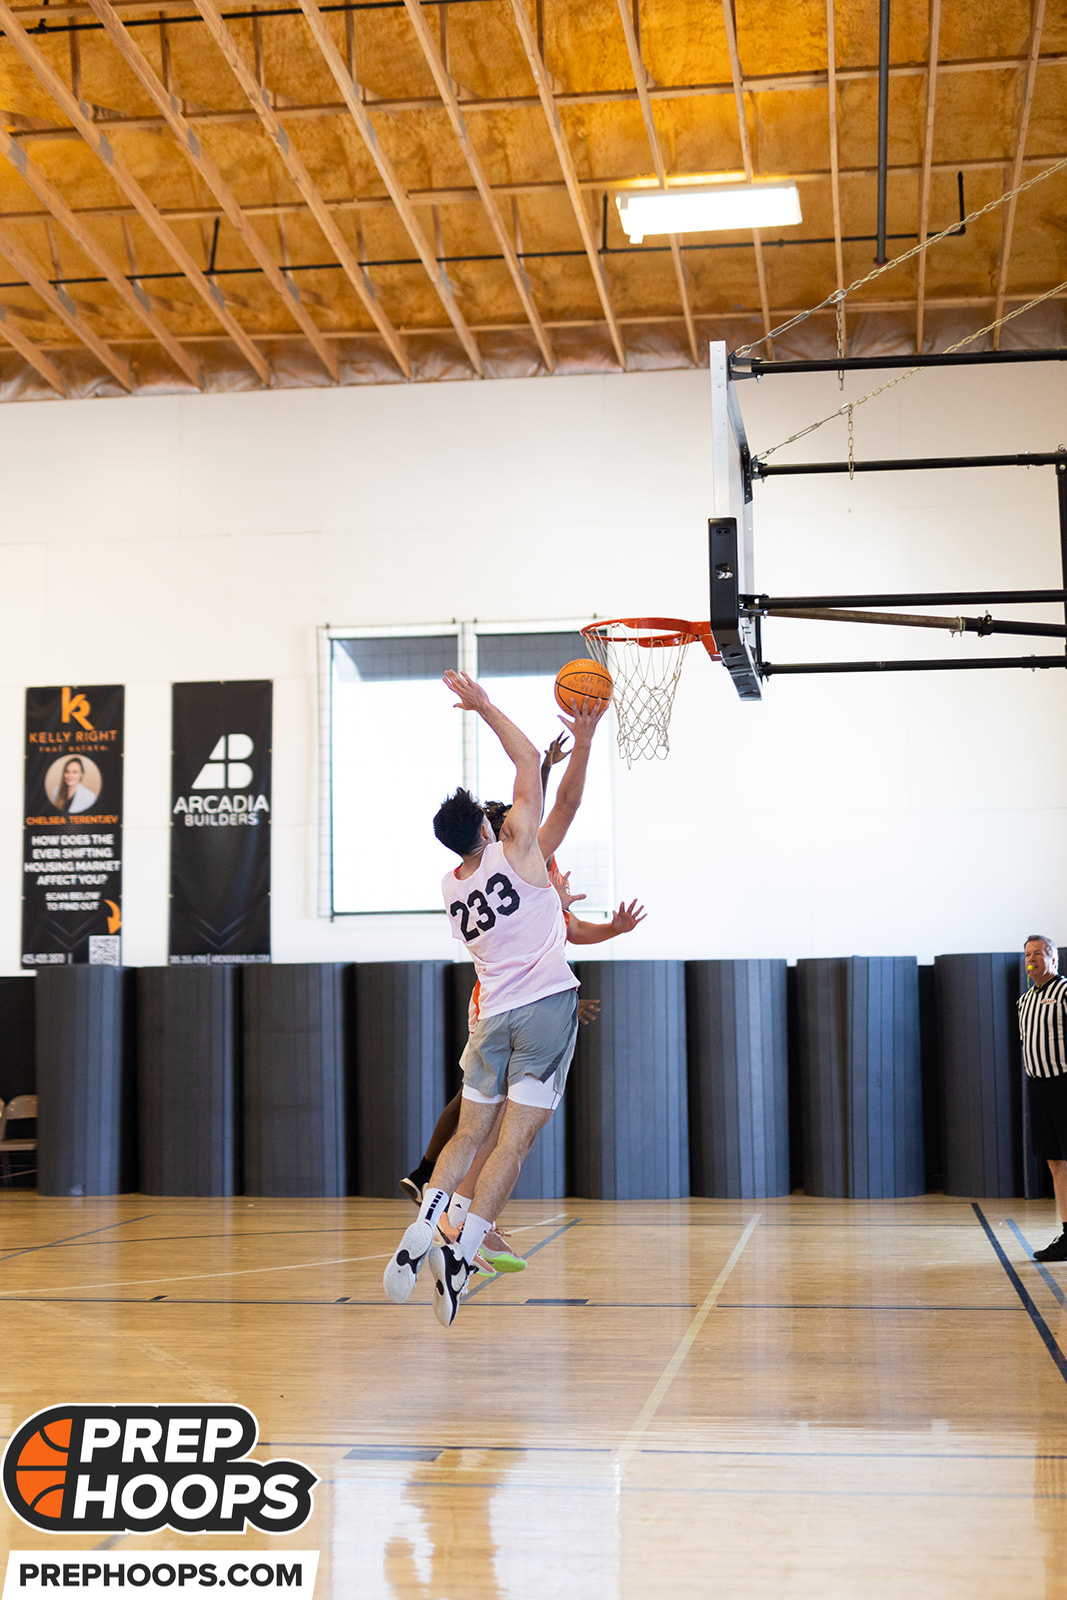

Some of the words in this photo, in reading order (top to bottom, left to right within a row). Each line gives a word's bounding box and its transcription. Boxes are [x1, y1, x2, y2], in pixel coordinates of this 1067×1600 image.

[29, 731, 71, 744] KELLY
[75, 730, 118, 742] RIGHT
[173, 794, 270, 814] ARCADIA
[25, 815, 66, 825] CHELSEA
[184, 812, 260, 827] BUILDERS
[31, 835, 60, 846] HOW
[60, 834, 91, 846] DOES
[91, 833, 114, 845] THE
[32, 848, 61, 859] EVER
[62, 847, 113, 859] SHIFTING
[24, 861, 75, 873] HOUSING
[75, 860, 121, 872] MARKET
[36, 874, 78, 886] AFFECT
[78, 873, 109, 885] YOU?
[45, 891, 69, 901] SCAN
[69, 891, 101, 901] BELOW
[46, 902, 58, 911] TO
[59, 901, 80, 911] FIND
[80, 901, 99, 911] OUT
[450, 872, 521, 942] 233
